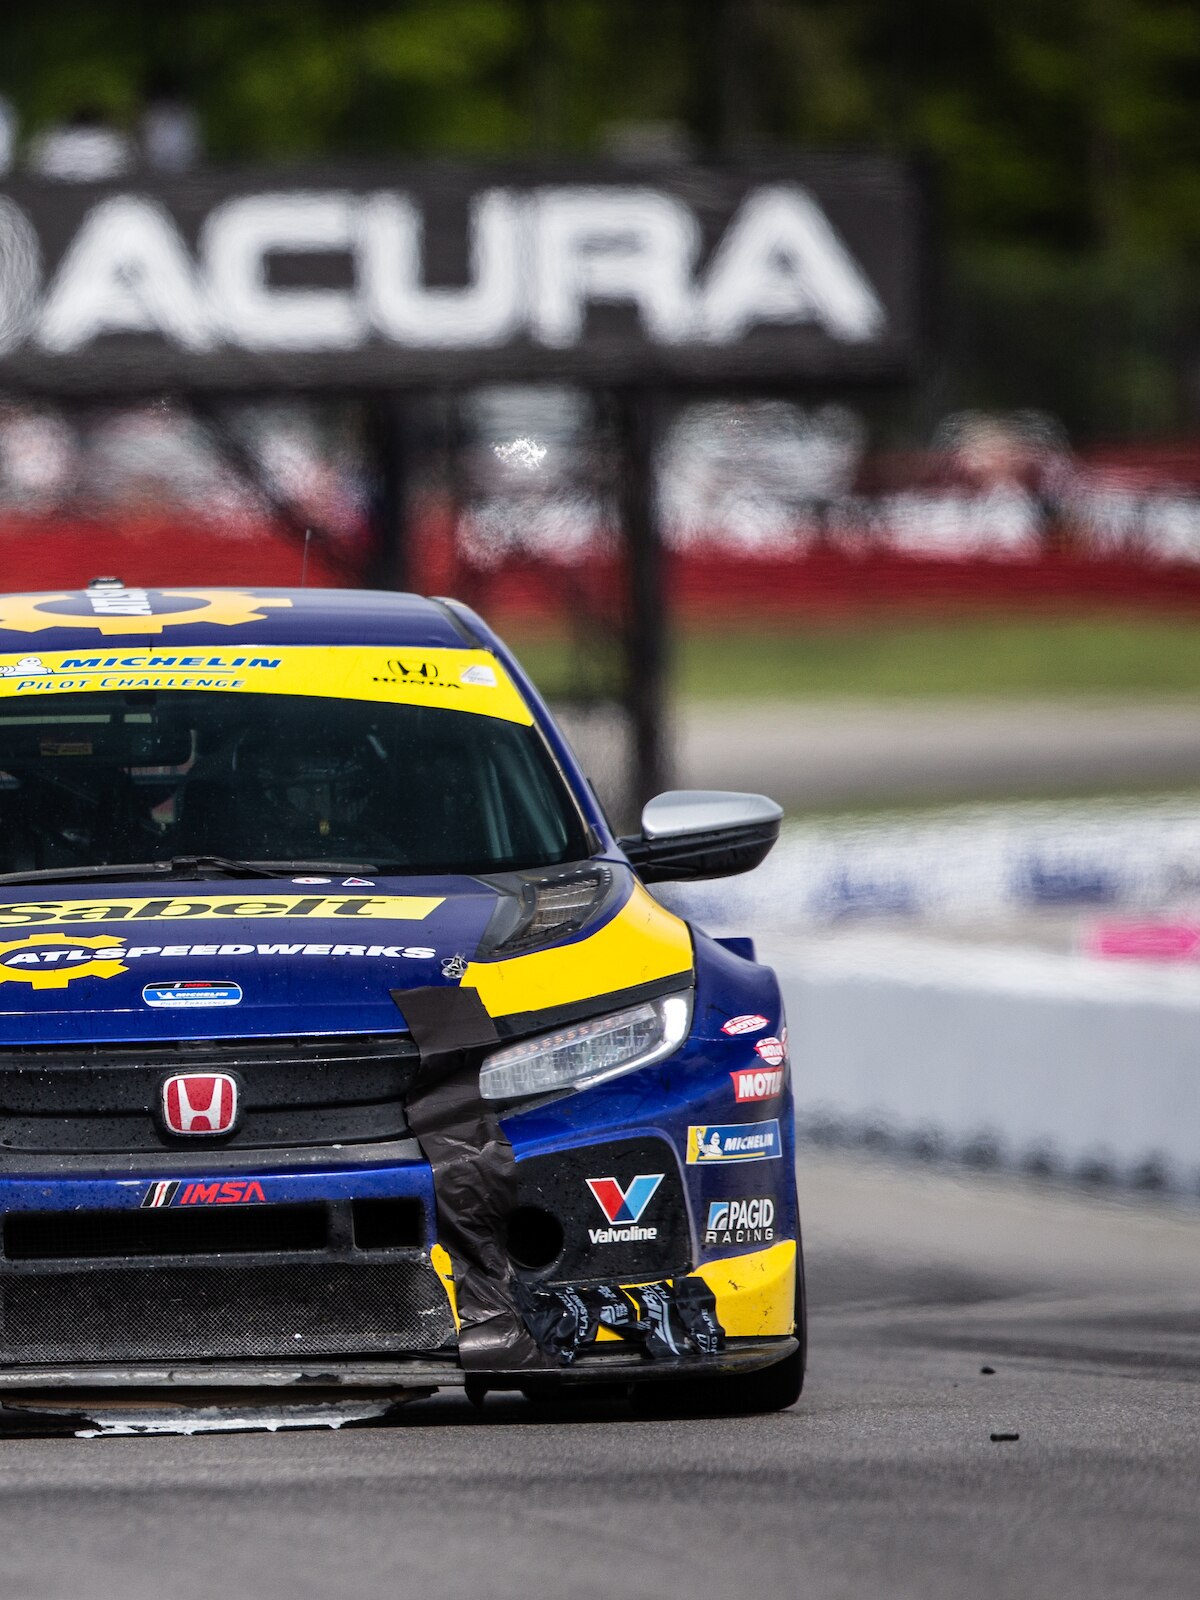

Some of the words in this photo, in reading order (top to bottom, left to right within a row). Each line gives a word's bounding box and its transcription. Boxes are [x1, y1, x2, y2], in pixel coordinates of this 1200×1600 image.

[38, 186, 886, 349] ACURA
[59, 656, 282, 670] MICHELIN
[16, 679, 93, 691] PILOT
[100, 676, 246, 689] CHALLENGE
[5, 944, 437, 966] ATLSPEEDWERKS
[174, 991, 229, 999] MICHELIN
[723, 1132, 774, 1151] MICHELIN
[180, 1181, 266, 1205] IMSA
[728, 1199, 775, 1230] PAGID
[588, 1225, 658, 1245] Valvoline
[705, 1226, 774, 1244] RACING
